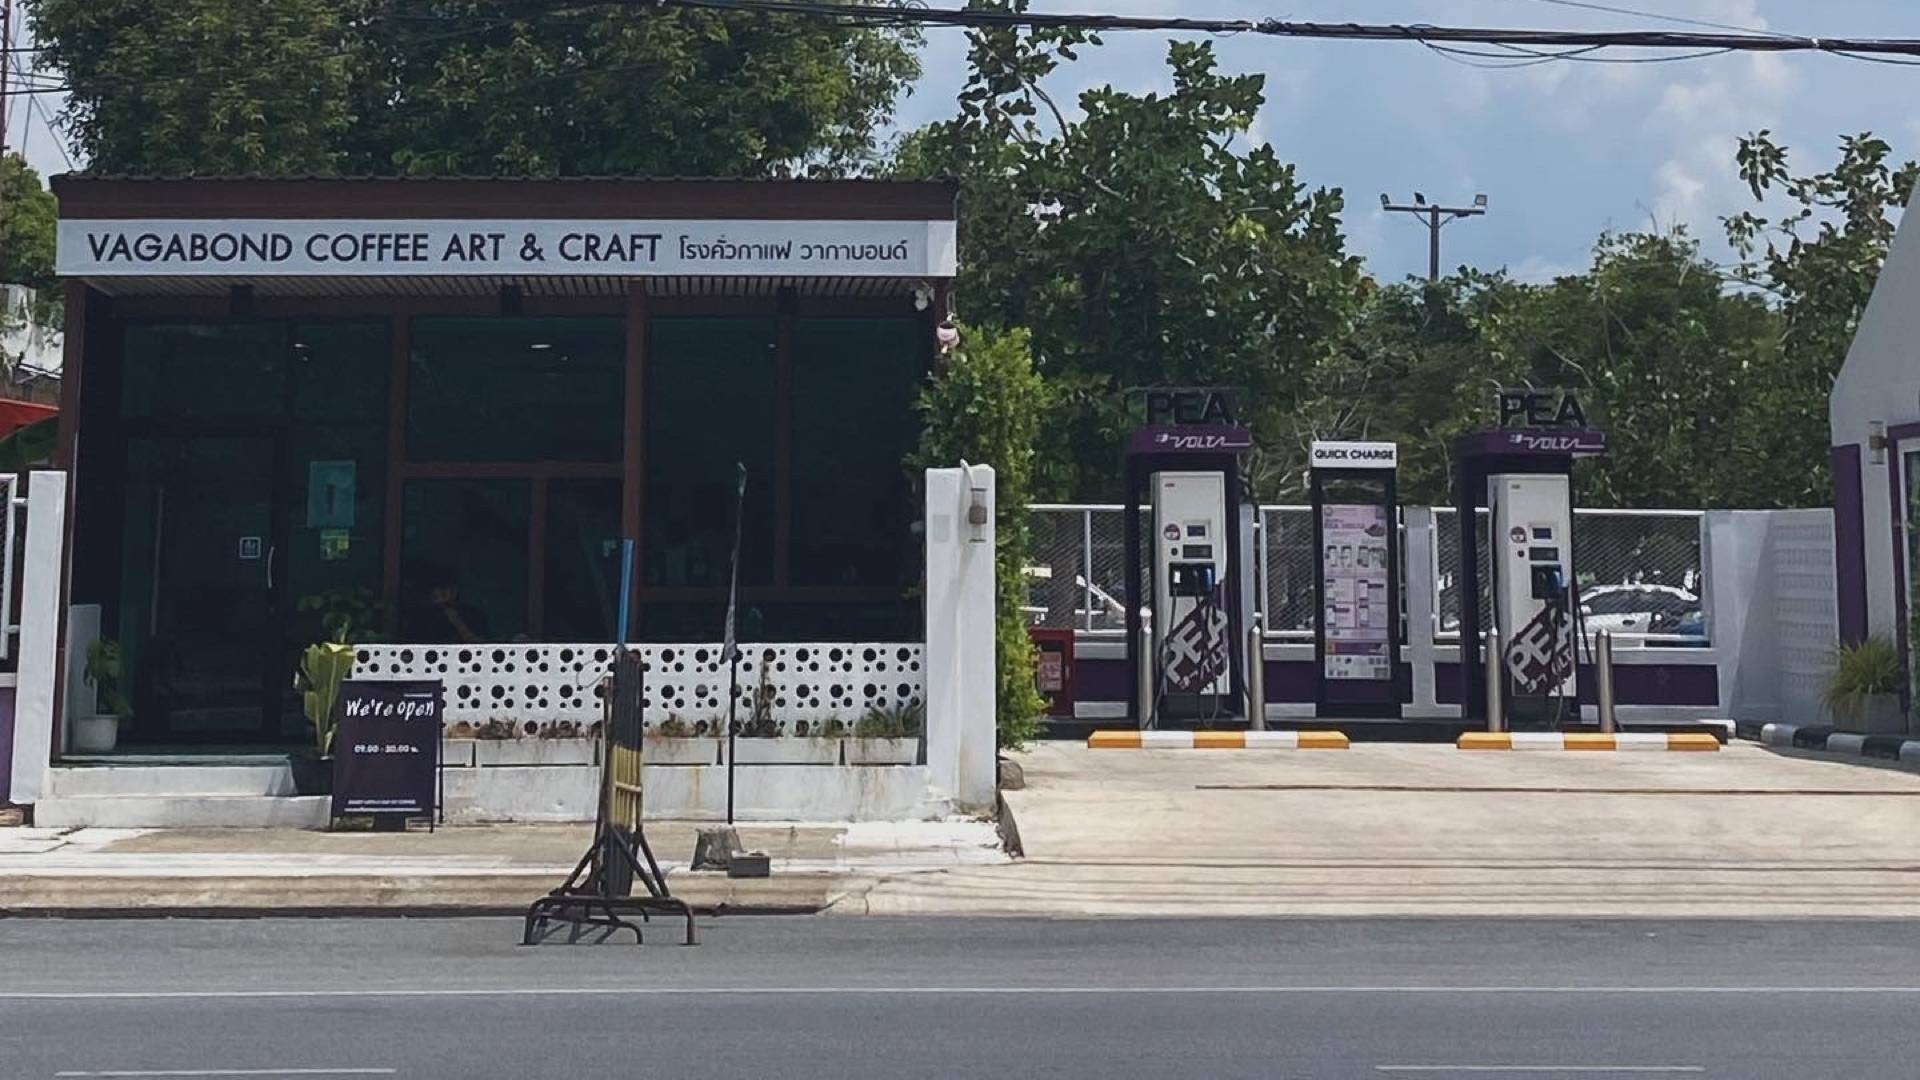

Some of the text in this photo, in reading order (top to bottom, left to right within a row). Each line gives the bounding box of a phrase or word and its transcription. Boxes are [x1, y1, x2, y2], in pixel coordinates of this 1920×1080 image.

[87, 232, 663, 262] VAGABOND COFFEE ART & CRAFT
[679, 234, 908, 261] โรงคั่วกาแฟ วากาบอนด์
[1145, 391, 1236, 425] PEA
[1499, 392, 1588, 427] PEA
[1315, 449, 1394, 460] QUICK CHARGE
[346, 697, 434, 721] We're open
